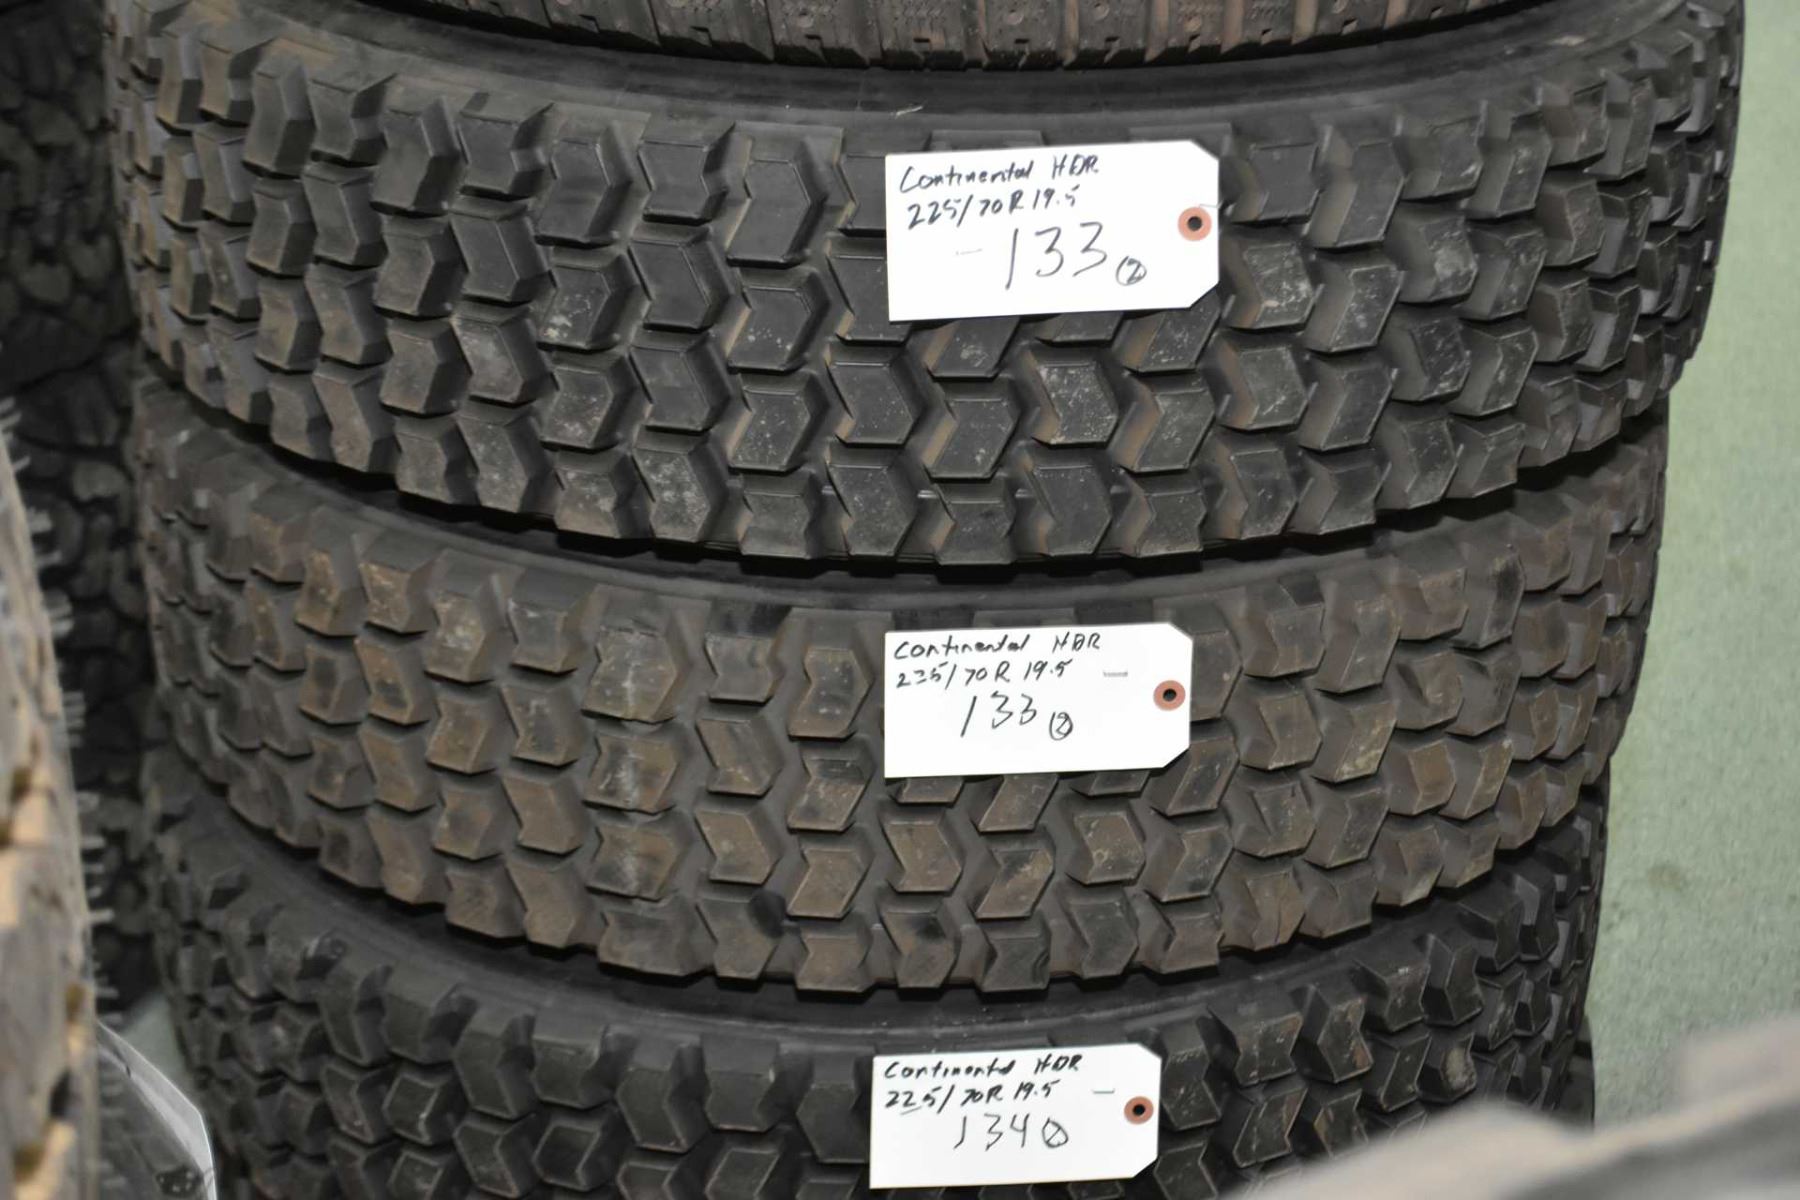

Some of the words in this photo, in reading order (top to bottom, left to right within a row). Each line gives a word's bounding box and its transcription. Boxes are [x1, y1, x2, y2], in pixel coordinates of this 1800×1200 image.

[899, 160, 1035, 194] Continental
[1005, 221, 1108, 290] 133
[893, 633, 1031, 660] Continental
[960, 690, 1037, 738] 133
[883, 1057, 1017, 1080] Continental
